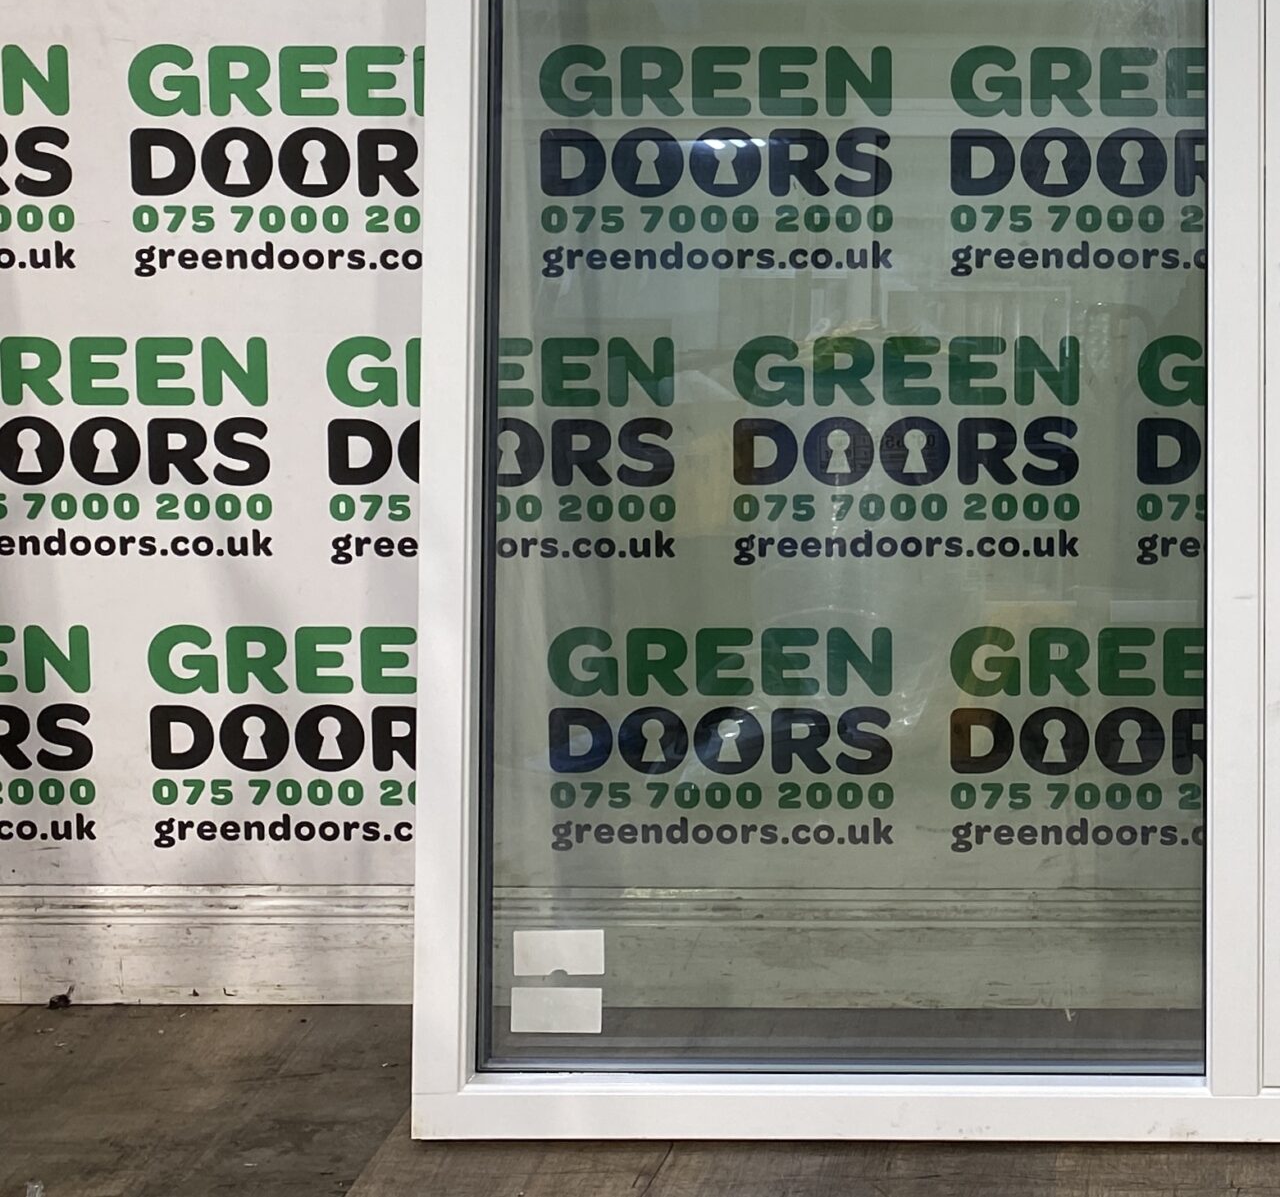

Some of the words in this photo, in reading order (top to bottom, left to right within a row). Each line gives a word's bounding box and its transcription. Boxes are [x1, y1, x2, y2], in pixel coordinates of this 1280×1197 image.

[128, 44, 423, 117] GREE
[539, 44, 892, 117] GREEN
[130, 127, 420, 198] DOOR
[540, 127, 892, 198] DOORS
[133, 205, 215, 233] 075
[231, 205, 348, 233] 7000
[541, 205, 624, 234] 075
[640, 205, 759, 233] 7000
[775, 204, 893, 233] 2000
[951, 205, 1032, 232] 075
[1048, 205, 1164, 233] 7000
[542, 240, 892, 278] greendoors.co.uk
[0, 336, 268, 406] REEN
[733, 335, 1080, 407] GREEN
[733, 416, 1079, 486] DOORS
[23, 493, 139, 520] 7000
[156, 493, 272, 521] 2000
[330, 494, 411, 521] 075
[559, 494, 676, 523] 2000
[733, 494, 815, 522] 075
[831, 493, 947, 521] 7000
[964, 493, 1080, 521] 2000
[733, 529, 1079, 566] greendoors.co.uk
[148, 625, 416, 694] GREE
[547, 626, 892, 697] GREEN
[548, 706, 893, 775] DOORS
[153, 779, 233, 805] 075
[248, 779, 364, 806] 7000
[550, 781, 631, 809] 075
[646, 782, 762, 809] 7000
[778, 782, 894, 809] 2000
[951, 782, 1031, 810] 075
[1047, 783, 1162, 810] 7000
[551, 816, 893, 851] greendoors.co.uk
